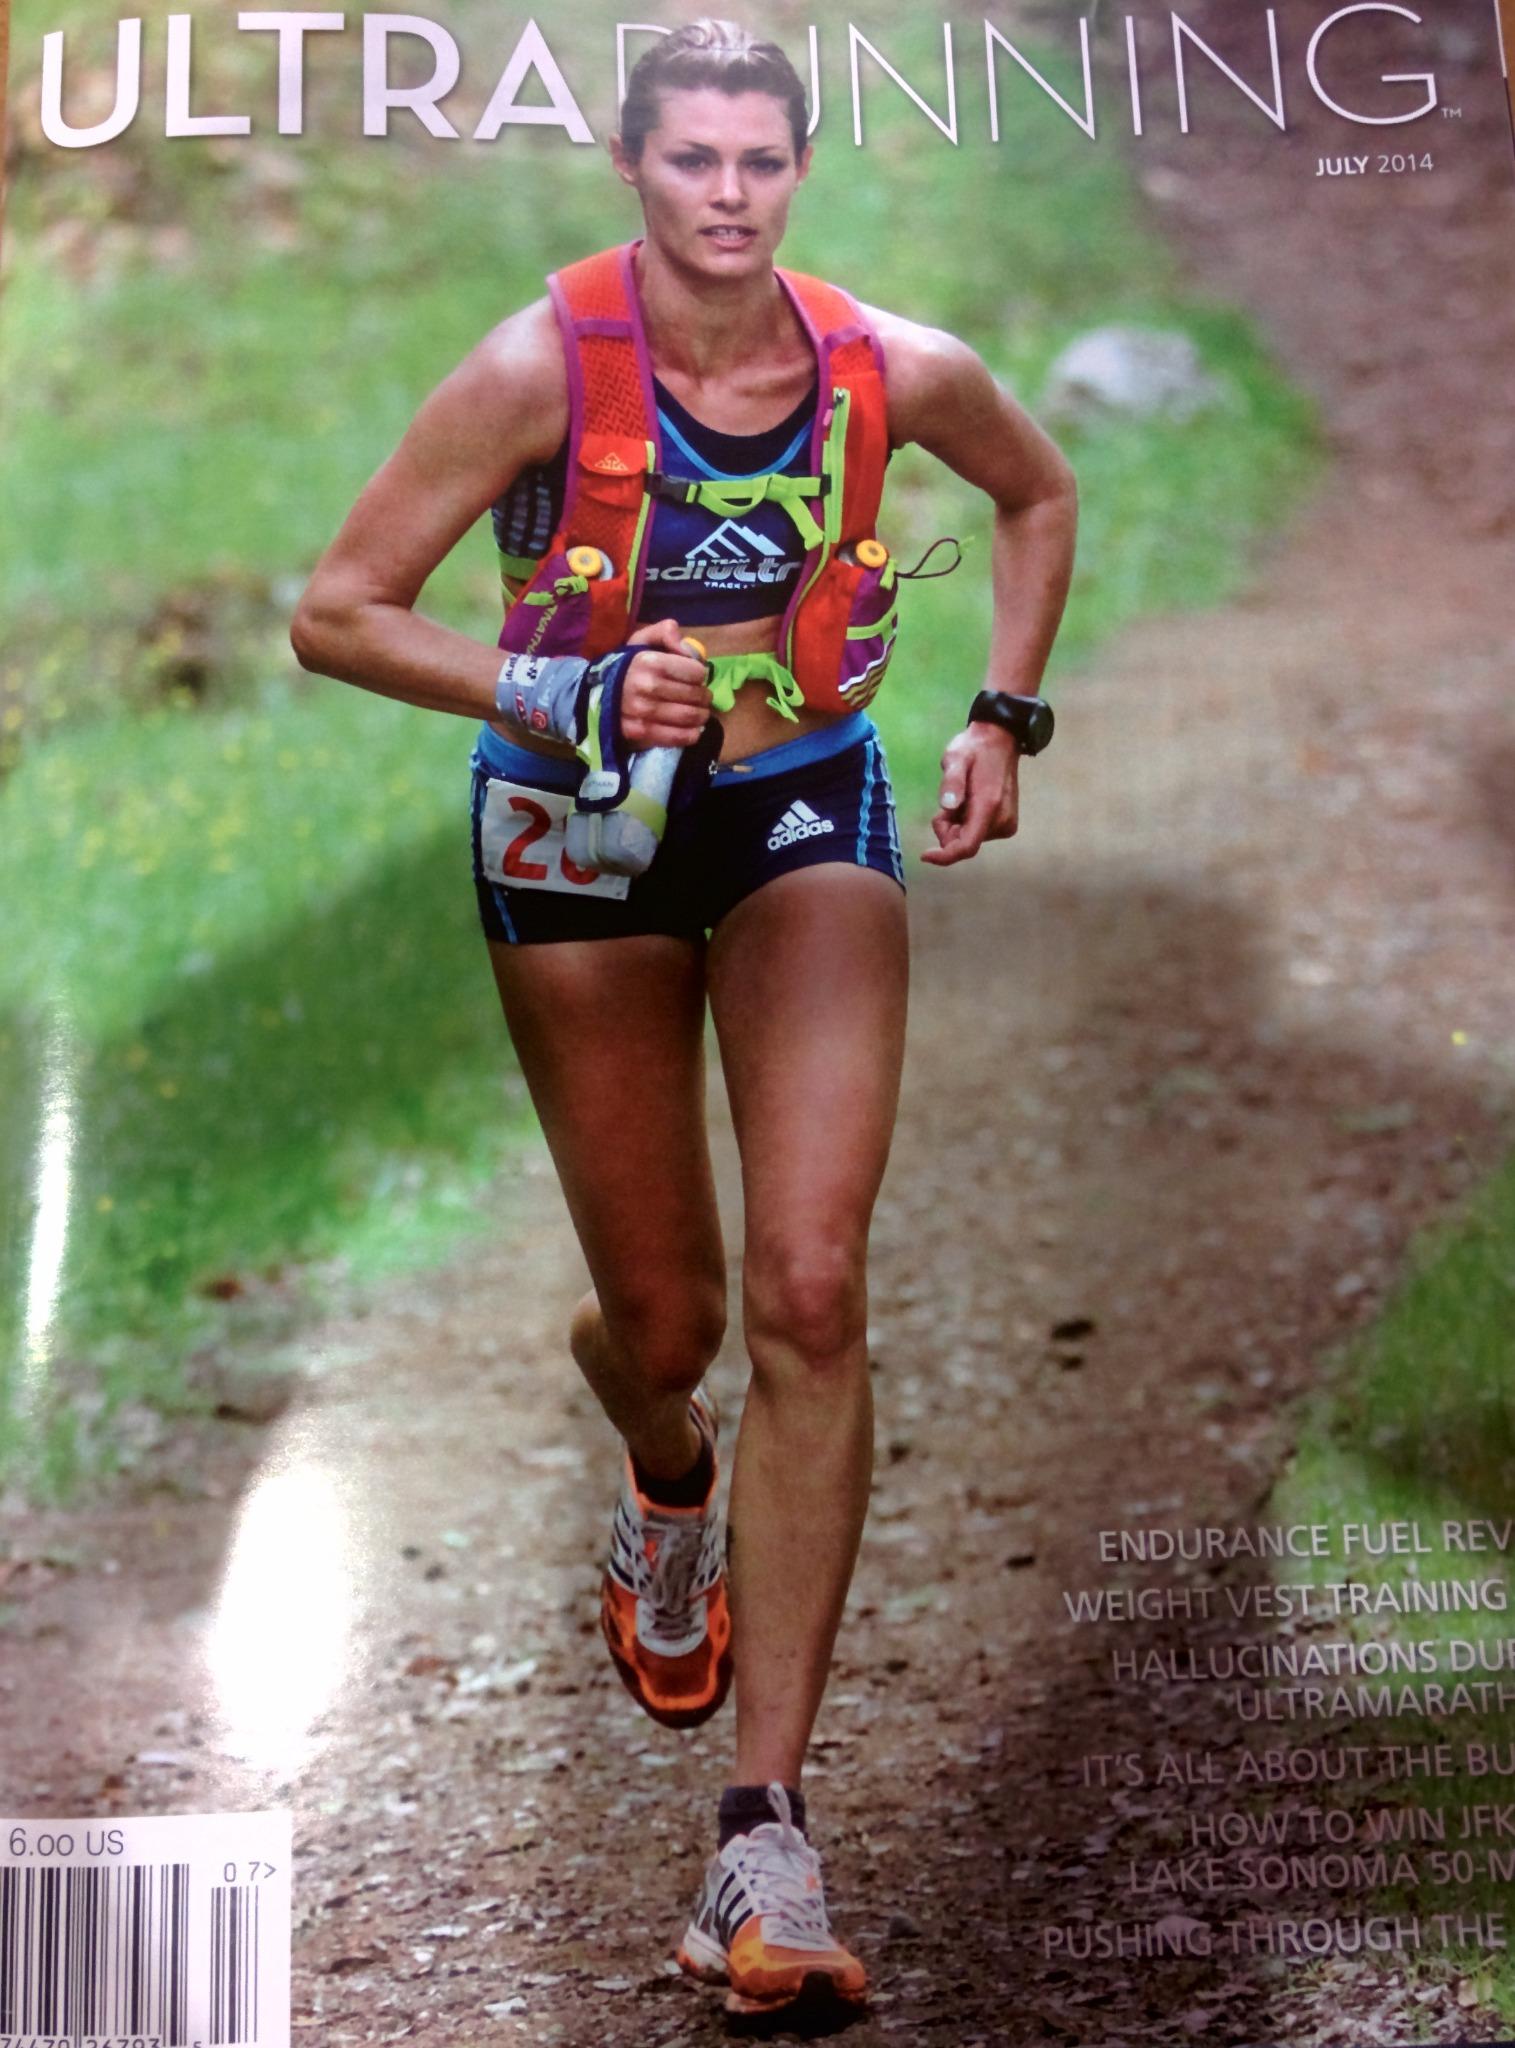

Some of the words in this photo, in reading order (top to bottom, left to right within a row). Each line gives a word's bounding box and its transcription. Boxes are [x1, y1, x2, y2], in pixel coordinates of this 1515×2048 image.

[1315, 155, 1369, 176] JULY
[1377, 152, 1434, 173] 2014
[767, 819, 835, 851] adidas
[1099, 1525, 1330, 1562] ENDURANCE
[1343, 1522, 1432, 1555] FUEL
[1441, 1519, 1514, 1551] REV
[1063, 1587, 1214, 1622] WEIGHT
[1225, 1585, 1313, 1618] VEST
[1325, 1579, 1508, 1614] TRAINING
[1113, 1640, 1437, 1681] HALLUCINATIONS
[1236, 1681, 1515, 1721] ULTRAMARATH
[1082, 1753, 1144, 1788] IT'S
[1155, 1752, 1225, 1785] ALL
[1236, 1747, 1370, 1783] ABOUT
[1379, 1744, 1455, 1779] THE
[9, 1827, 75, 1857] 6.00
[86, 1829, 125, 1857] US
[1190, 1810, 1290, 1846] HOW
[1299, 1808, 1355, 1844] TO
[1364, 1806, 1447, 1843] WIN
[1459, 1804, 1515, 1840] JFK
[1129, 1857, 1227, 1894] LAKE
[1238, 1852, 1420, 1891] SONOMA
[1431, 1849, 1515, 1885] 50-M
[1044, 1923, 1213, 1960] PUSHING
[1223, 1916, 1420, 1956] THROUGH
[1437, 1912, 1508, 1949] THE
